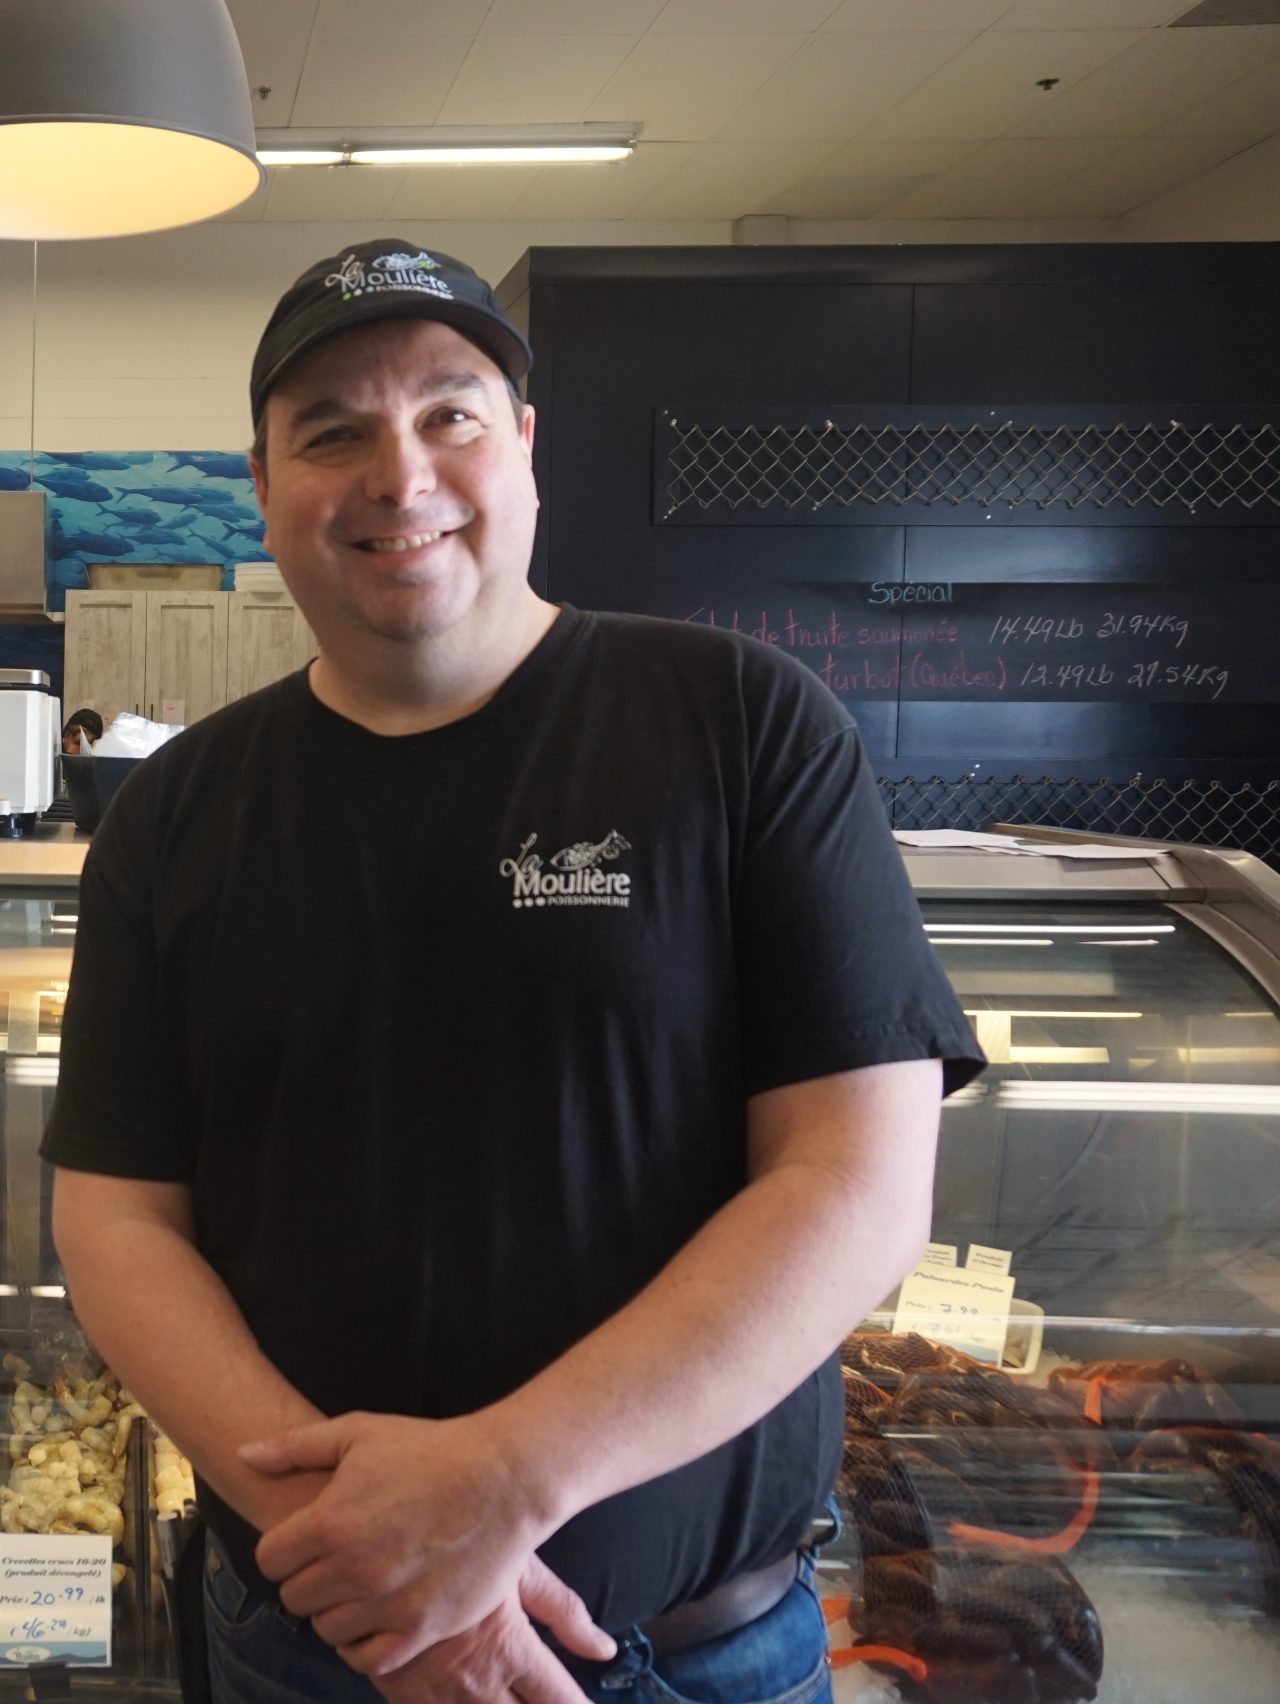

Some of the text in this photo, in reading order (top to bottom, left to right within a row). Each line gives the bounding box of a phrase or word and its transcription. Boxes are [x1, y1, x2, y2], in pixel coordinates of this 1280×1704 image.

[341, 266, 453, 294] Moulière
[784, 608, 856, 648] truite
[512, 866, 631, 898] Moulière
[2, 1556, 45, 1566] Crevettes
[47, 1558, 74, 1566] crues
[4, 1568, 102, 1578] (produit décongelé)
